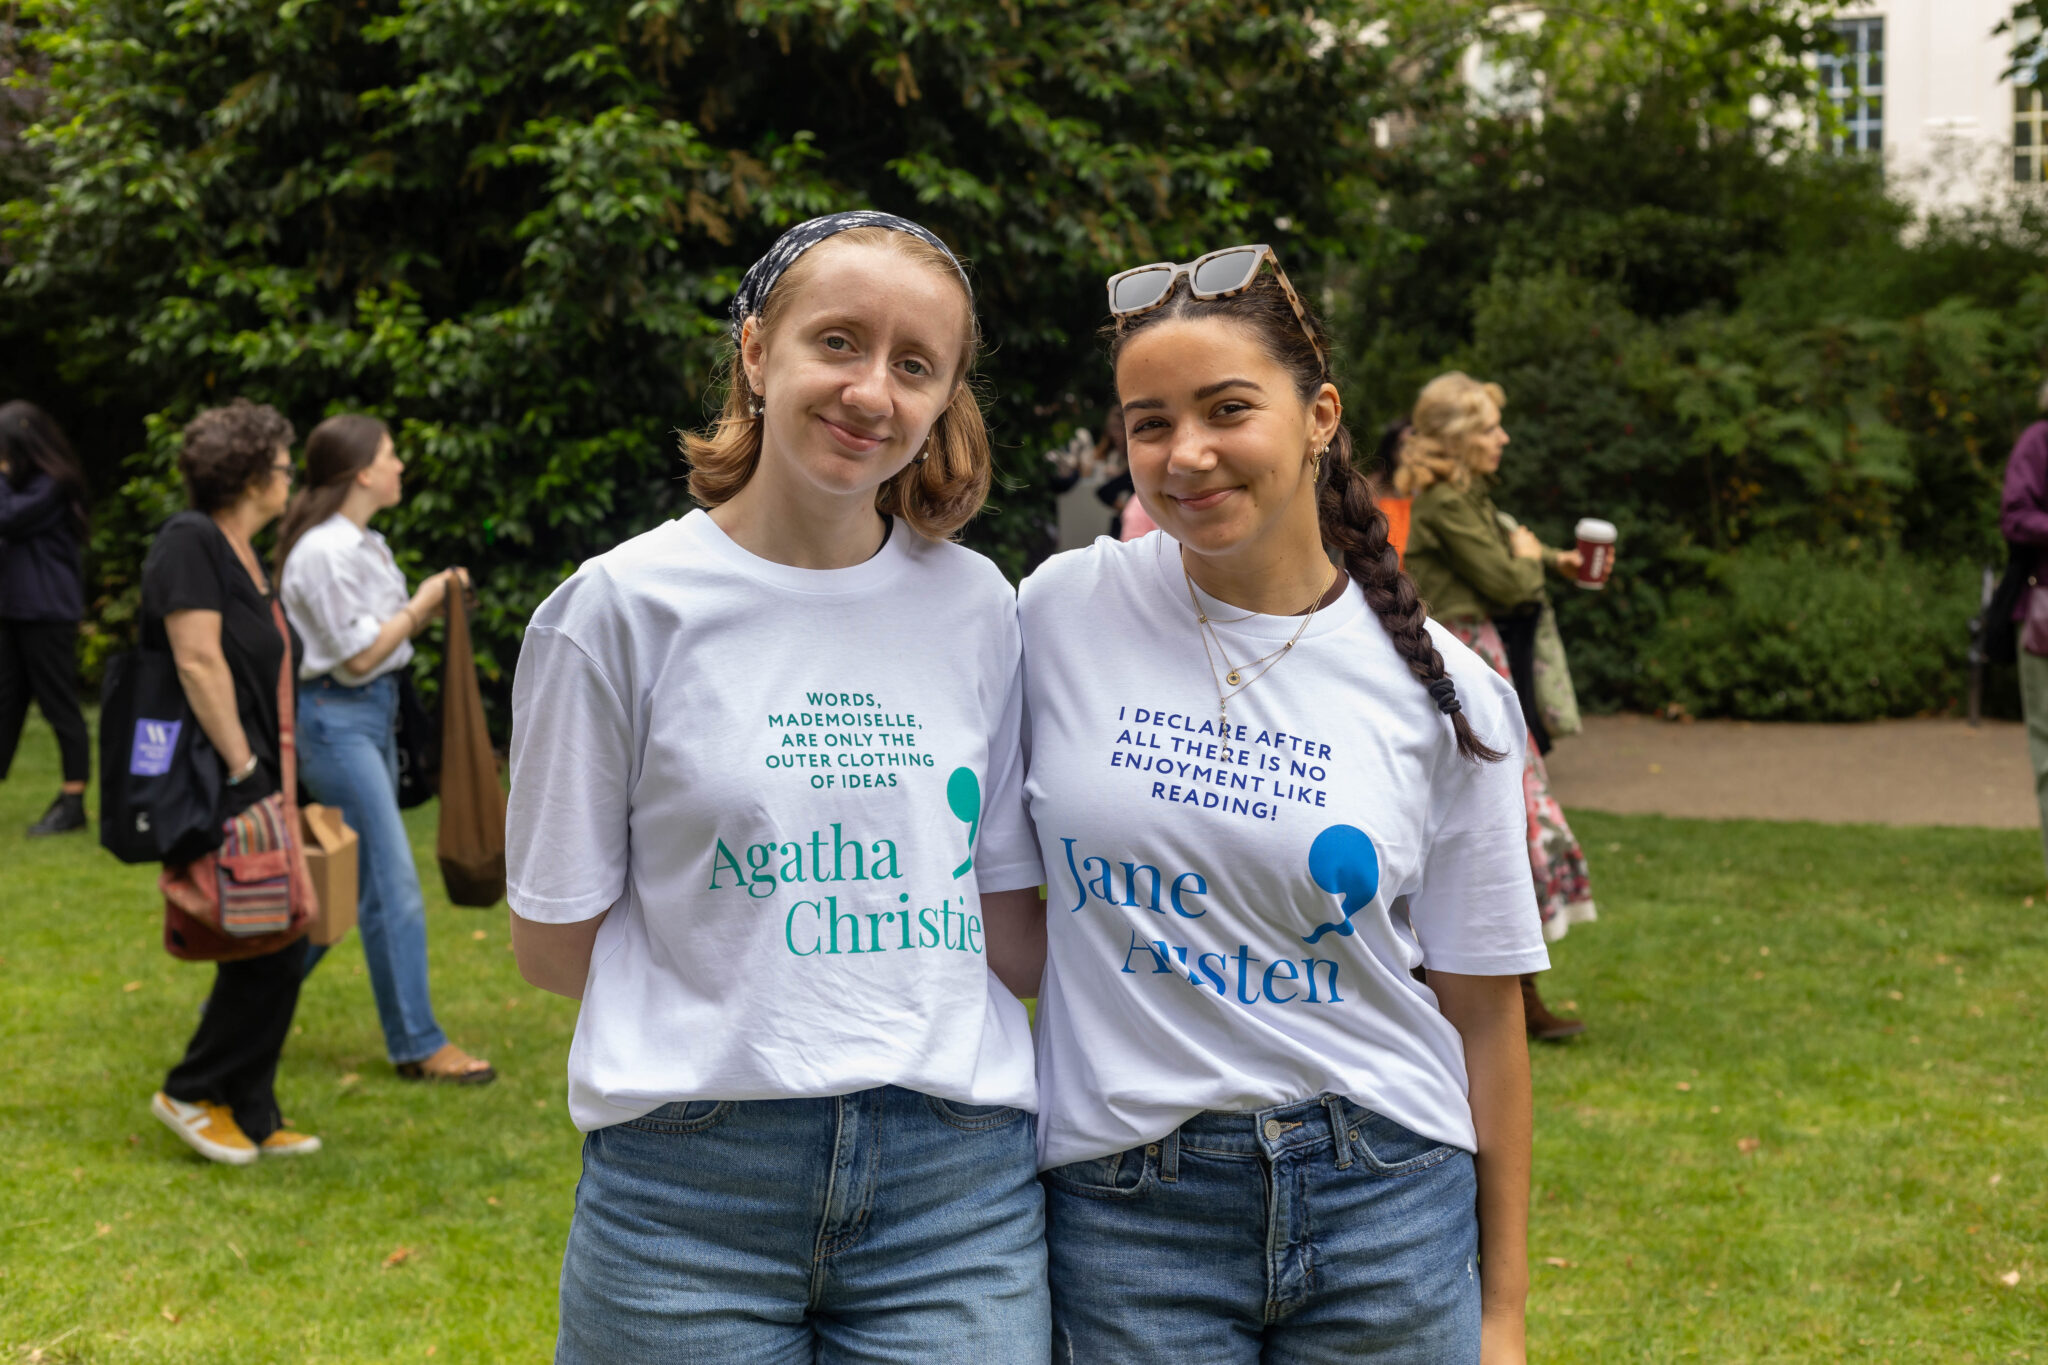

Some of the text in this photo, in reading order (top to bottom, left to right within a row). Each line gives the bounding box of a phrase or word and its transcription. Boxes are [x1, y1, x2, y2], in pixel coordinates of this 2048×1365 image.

[768, 713, 923, 730] MADEMOISELLE,
[806, 692, 882, 709] WORDS,
[781, 733, 915, 747] ARE ONLY THE
[1116, 729, 1326, 782] ALL THERE IS NO
[1119, 706, 1332, 761] I DECLARE AFTER
[765, 753, 935, 769] OUTER CLOTHING
[810, 773, 897, 789] OF IDEAS
[1110, 751, 1327, 808] ENJOYMENT LIKE
[1151, 781, 1277, 821] READING!
[709, 823, 904, 898] Agatha
[1059, 837, 1208, 919] Jane
[785, 892, 983, 956] Christie
